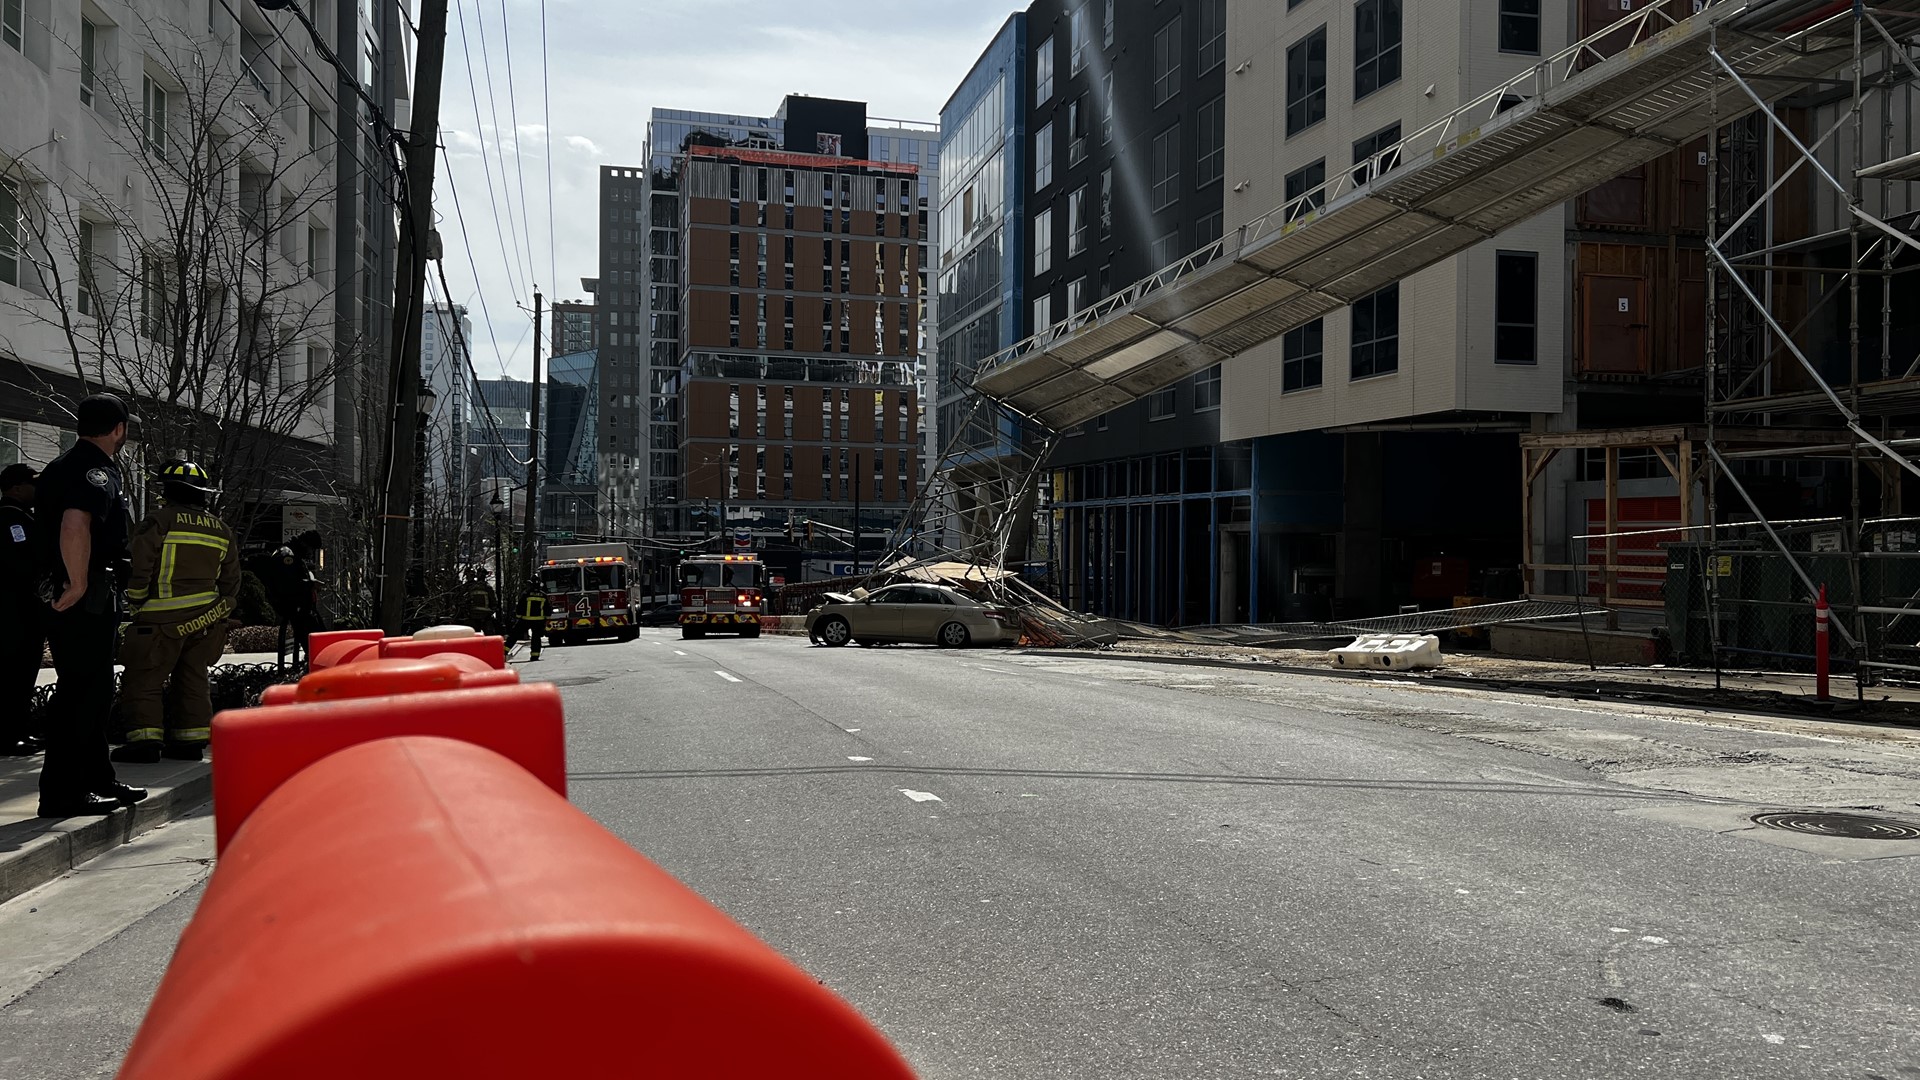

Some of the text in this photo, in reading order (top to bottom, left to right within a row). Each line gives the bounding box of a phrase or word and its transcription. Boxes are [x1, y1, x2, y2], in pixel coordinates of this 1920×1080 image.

[1701, 156, 1706, 164] 6
[1621, 302, 1626, 310] 5
[176, 512, 223, 531] ATLANTA
[575, 596, 592, 618] 4
[176, 599, 231, 637] RODRIGUEZ
